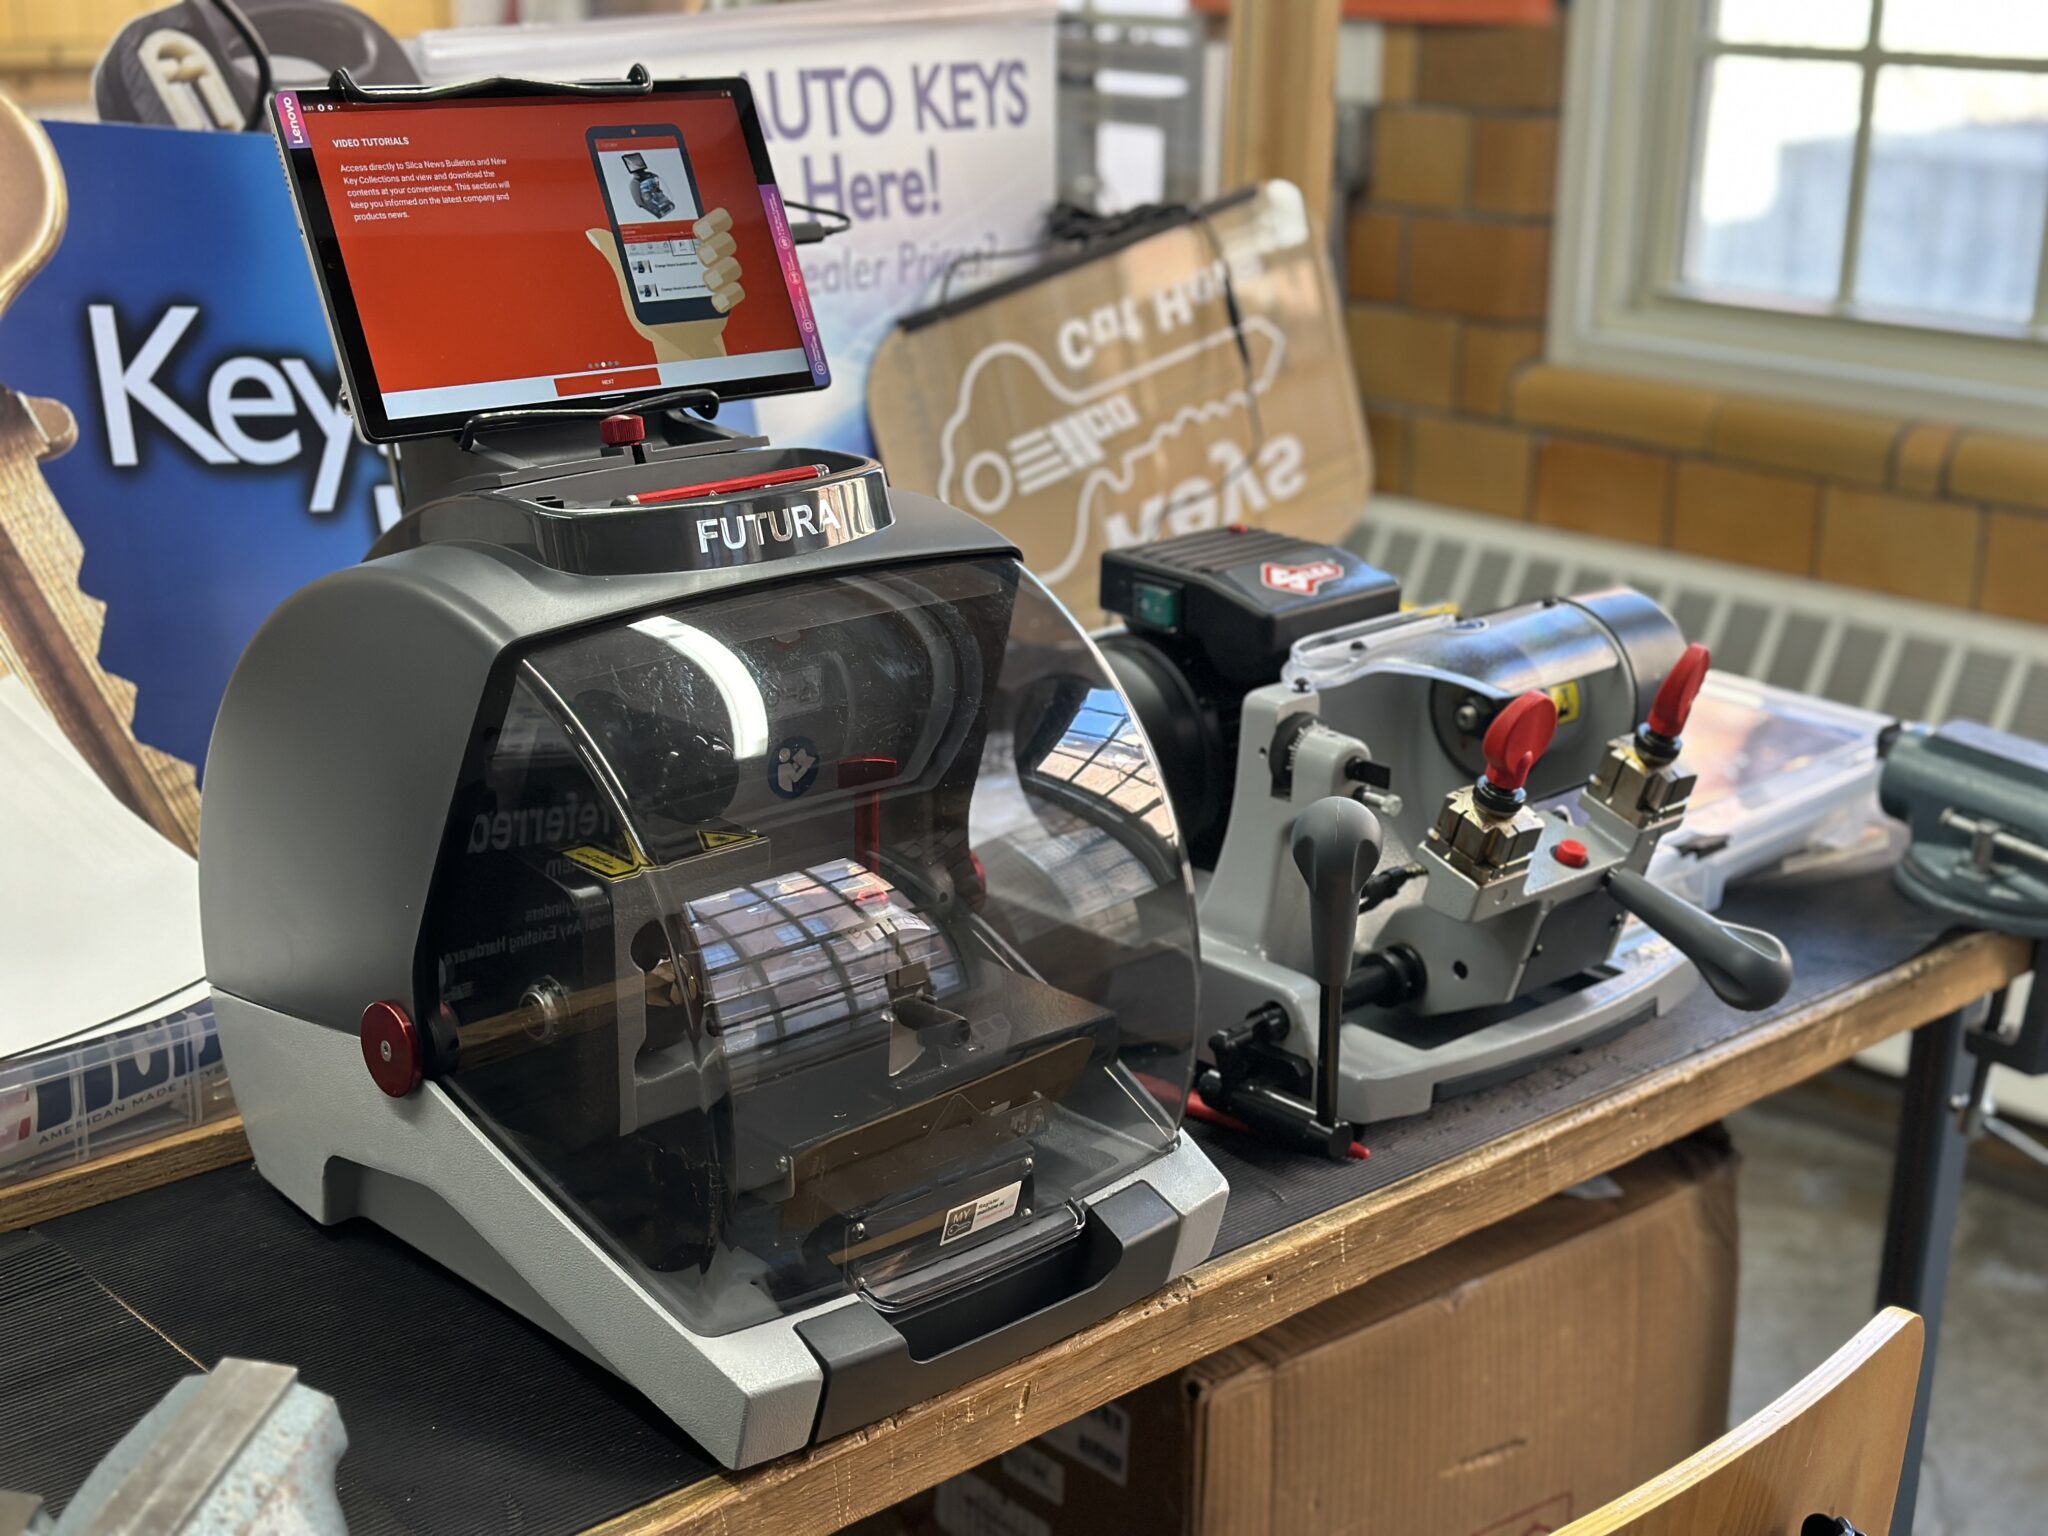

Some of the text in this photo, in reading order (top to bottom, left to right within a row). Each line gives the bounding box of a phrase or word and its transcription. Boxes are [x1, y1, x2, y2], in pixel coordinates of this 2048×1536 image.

[911, 59, 1029, 133] KEYS
[283, 97, 304, 144] Lenovo
[332, 136, 410, 148] VIDEO TUTORIALS
[340, 157, 507, 173] Access directly to Silca News Bulletins and New
[343, 169, 495, 186] Key Collections and view and download the
[801, 147, 941, 222] Here!
[347, 180, 511, 197] contents at your convenience. This section will
[350, 192, 510, 210] keep you informed on the latest company and
[353, 211, 410, 223] products news.
[88, 304, 388, 514] Key
[696, 499, 842, 554] FUTURA
[39, 1104, 125, 1145] AMERICAN
[132, 1085, 177, 1108] MADE
[953, 1208, 971, 1224] MY
